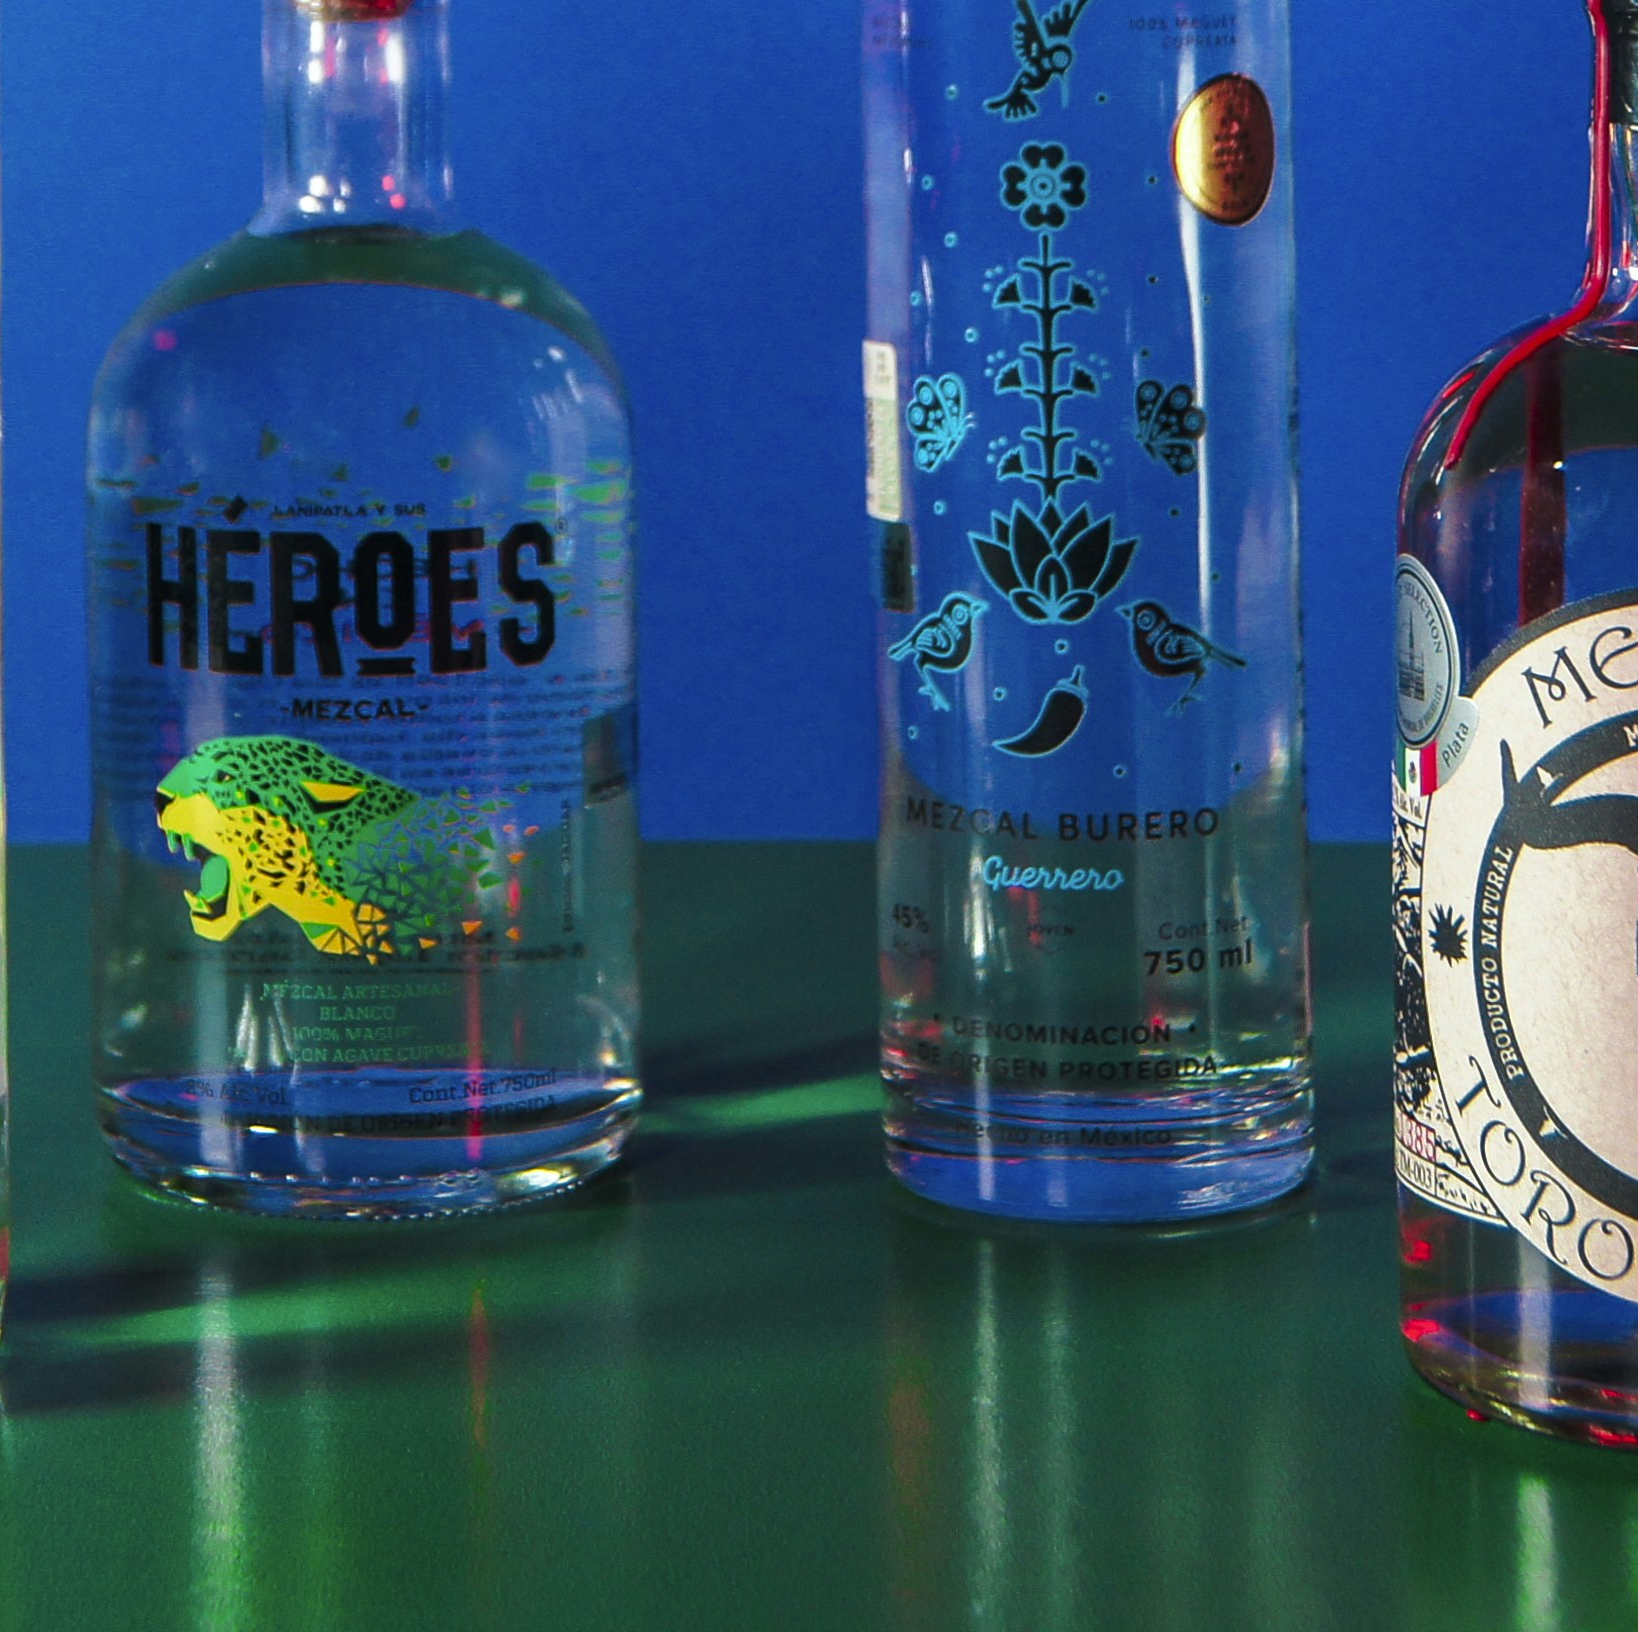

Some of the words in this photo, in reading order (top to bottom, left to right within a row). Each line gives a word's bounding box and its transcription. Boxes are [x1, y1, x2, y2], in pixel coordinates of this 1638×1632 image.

[1442, 721, 1470, 769] Plata
[906, 795, 1039, 840] MEZCAL
[1057, 807, 1220, 842] BURERO
[983, 855, 1126, 891] Guerrero
[1481, 846, 1513, 948] NATURAL
[1143, 948, 1206, 977] 750
[1219, 936, 1253, 968] ml
[318, 1005, 397, 1022] BLANCO
[1482, 957, 1526, 1081] PRODUCTO
[332, 1046, 395, 1063] AGAVE
[1058, 1054, 1218, 1082] PROTEGIDA
[1455, 1055, 1636, 1282] TORO
